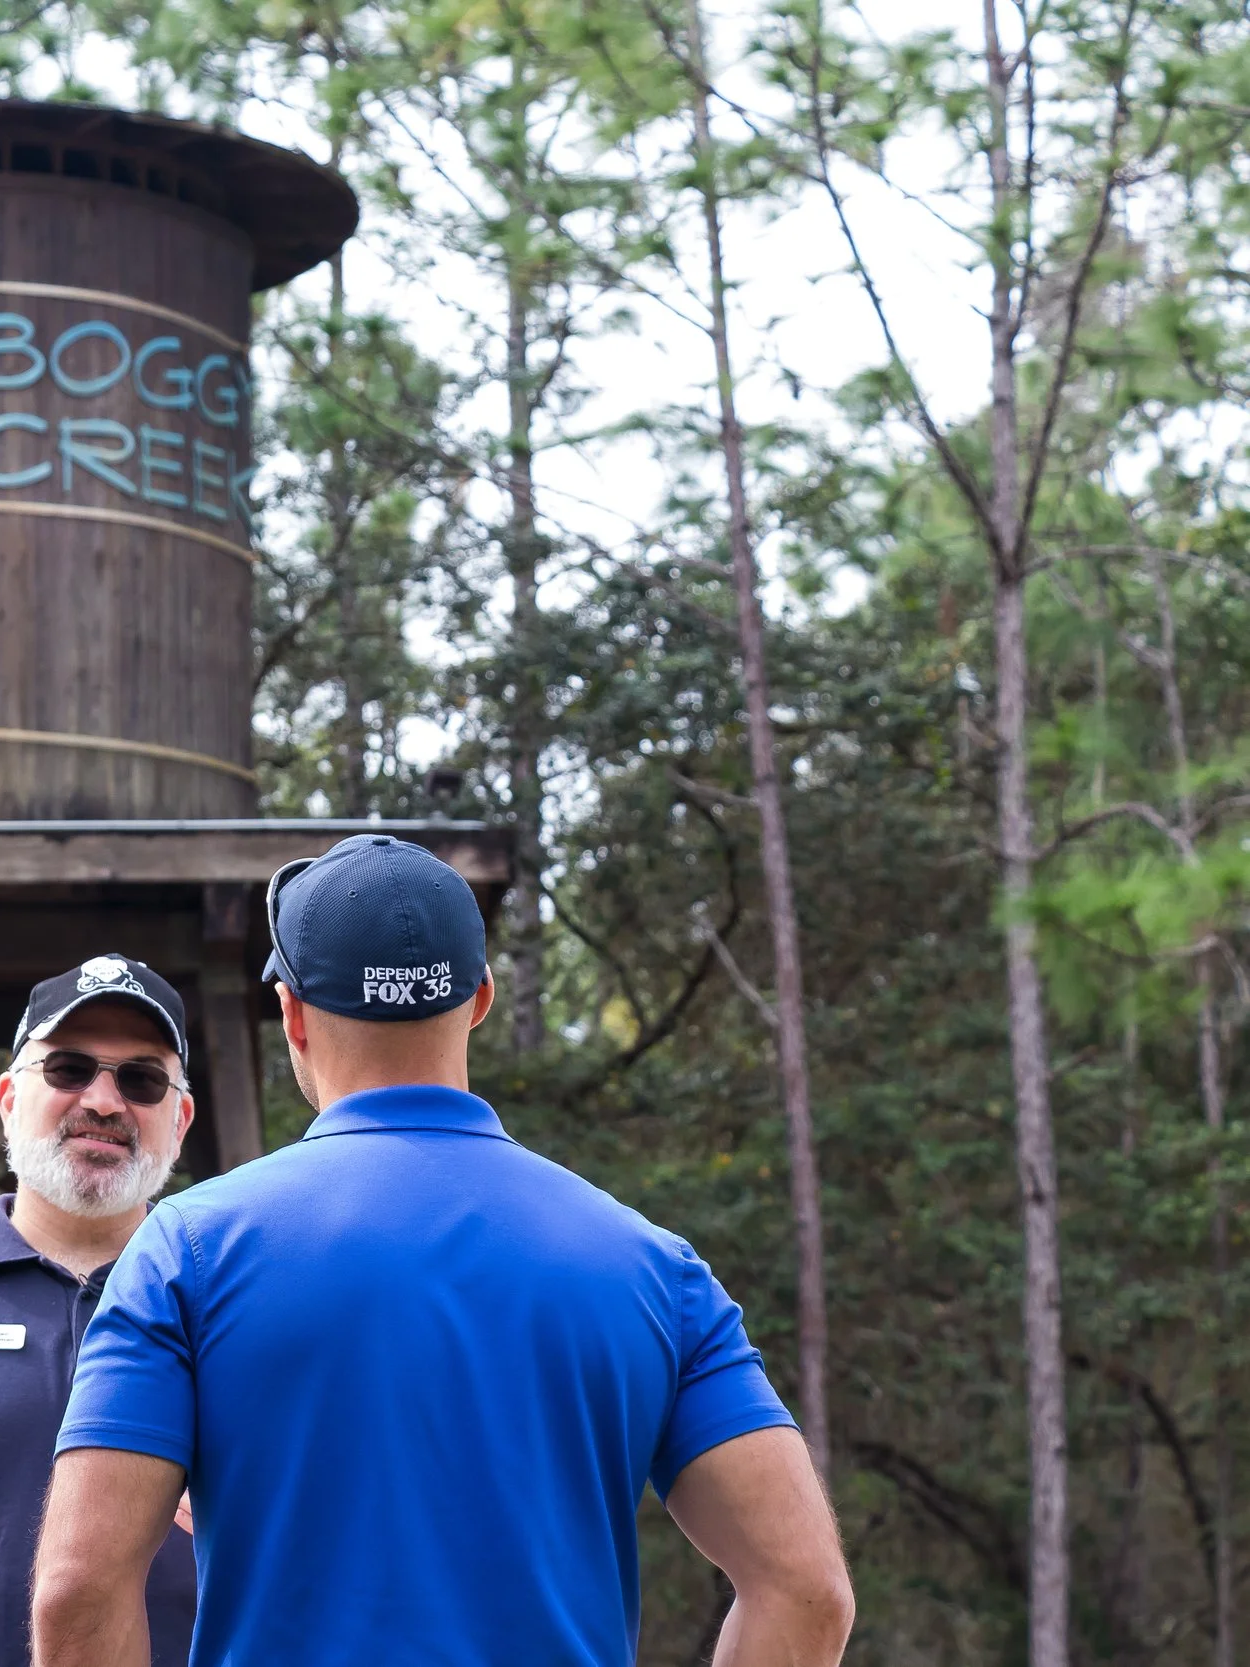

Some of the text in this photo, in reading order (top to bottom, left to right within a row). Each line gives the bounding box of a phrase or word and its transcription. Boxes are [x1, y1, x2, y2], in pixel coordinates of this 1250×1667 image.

[364, 961, 450, 981] DEPEND ON
[363, 975, 453, 1005] FOX 35
